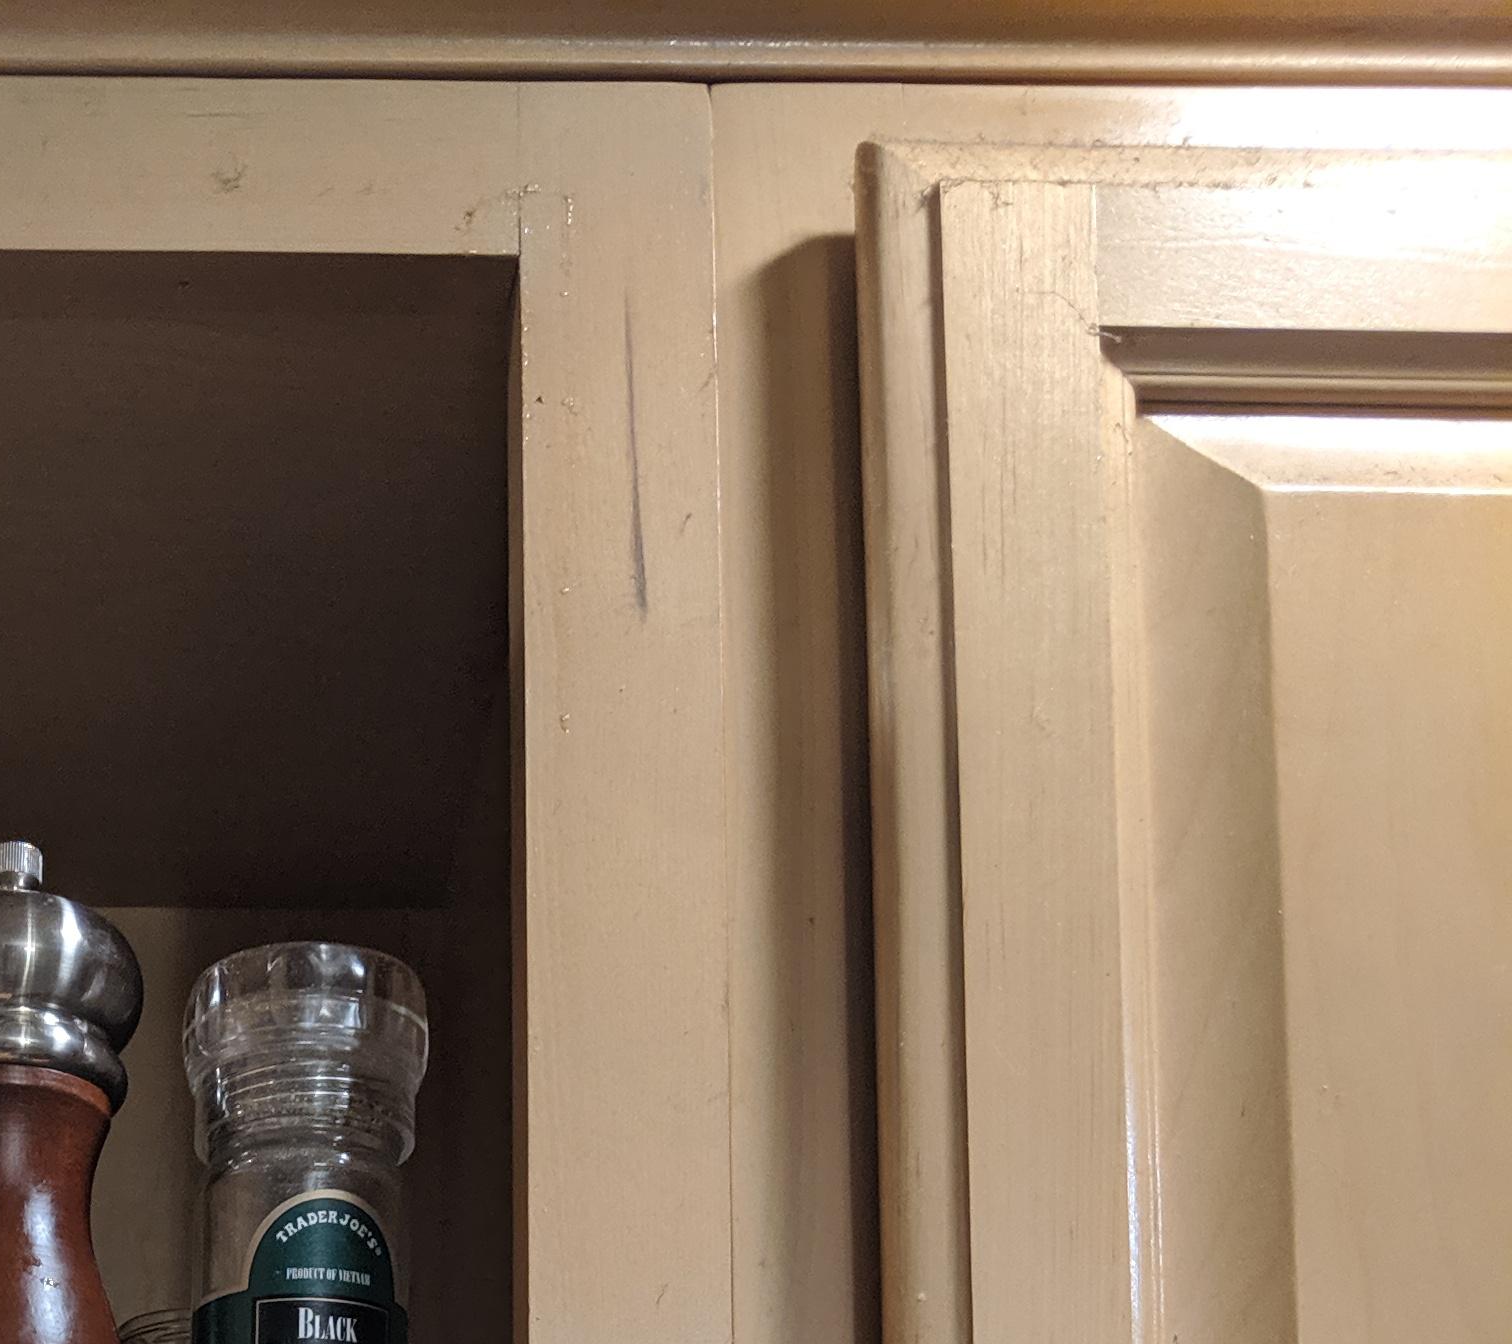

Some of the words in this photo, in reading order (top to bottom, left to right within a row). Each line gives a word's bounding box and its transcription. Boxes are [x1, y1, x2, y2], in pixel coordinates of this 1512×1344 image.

[275, 1210, 338, 1243] TRADER
[339, 1213, 378, 1250] JOE'S
[286, 1267, 326, 1280] PRODUCT
[326, 1268, 338, 1280] OF
[338, 1269, 371, 1286] VIETNAM
[297, 1306, 358, 1343] BLACK
